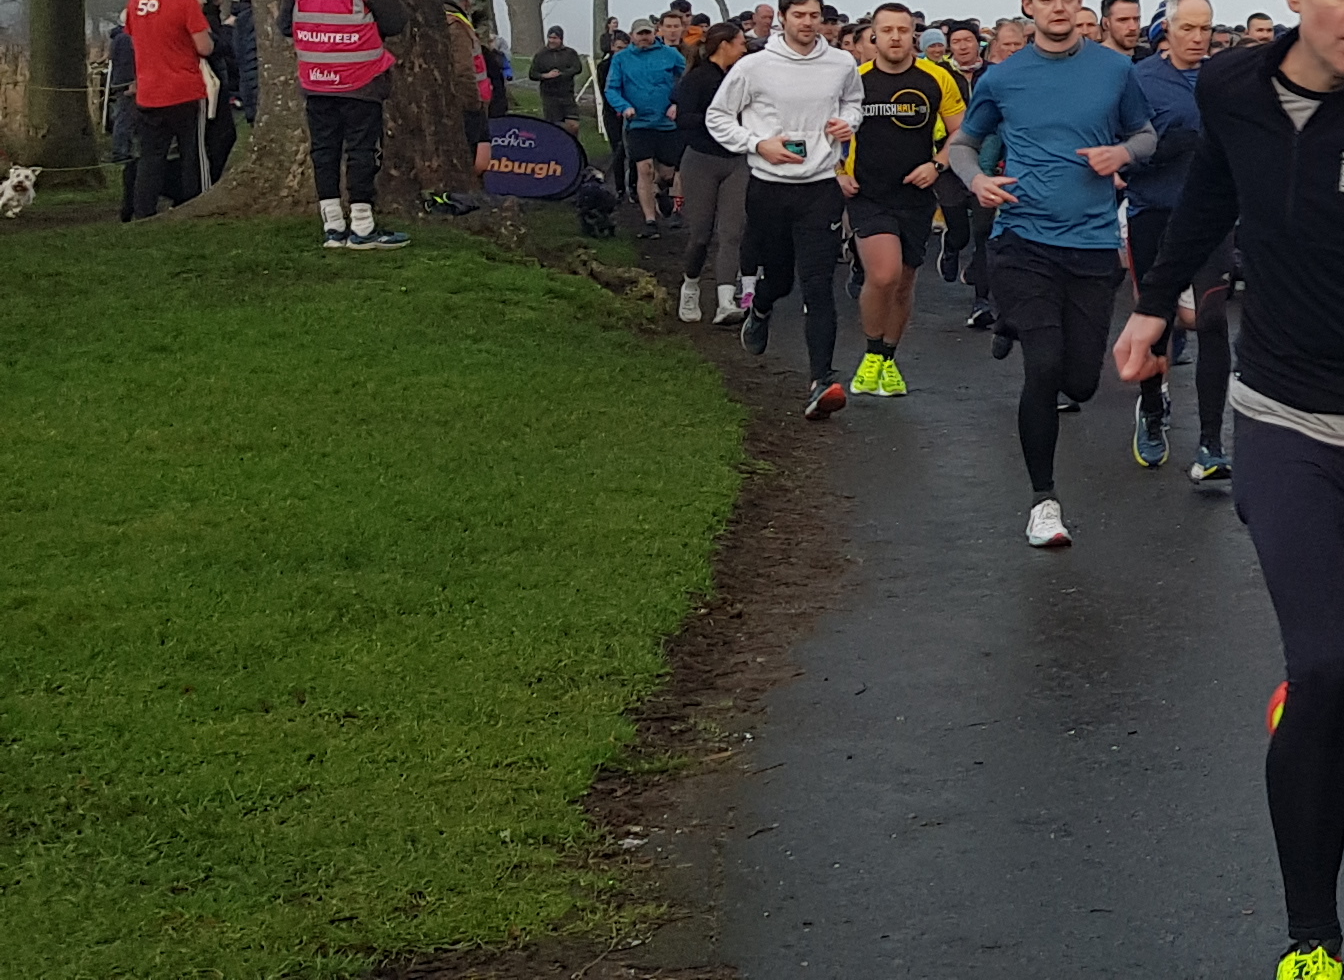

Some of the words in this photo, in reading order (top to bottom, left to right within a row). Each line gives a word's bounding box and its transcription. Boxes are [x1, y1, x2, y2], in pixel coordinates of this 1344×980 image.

[137, 0, 159, 16] 50
[296, 30, 359, 44] VOLUNTEER
[309, 68, 340, 84] Vitality
[491, 129, 535, 148] parkrun
